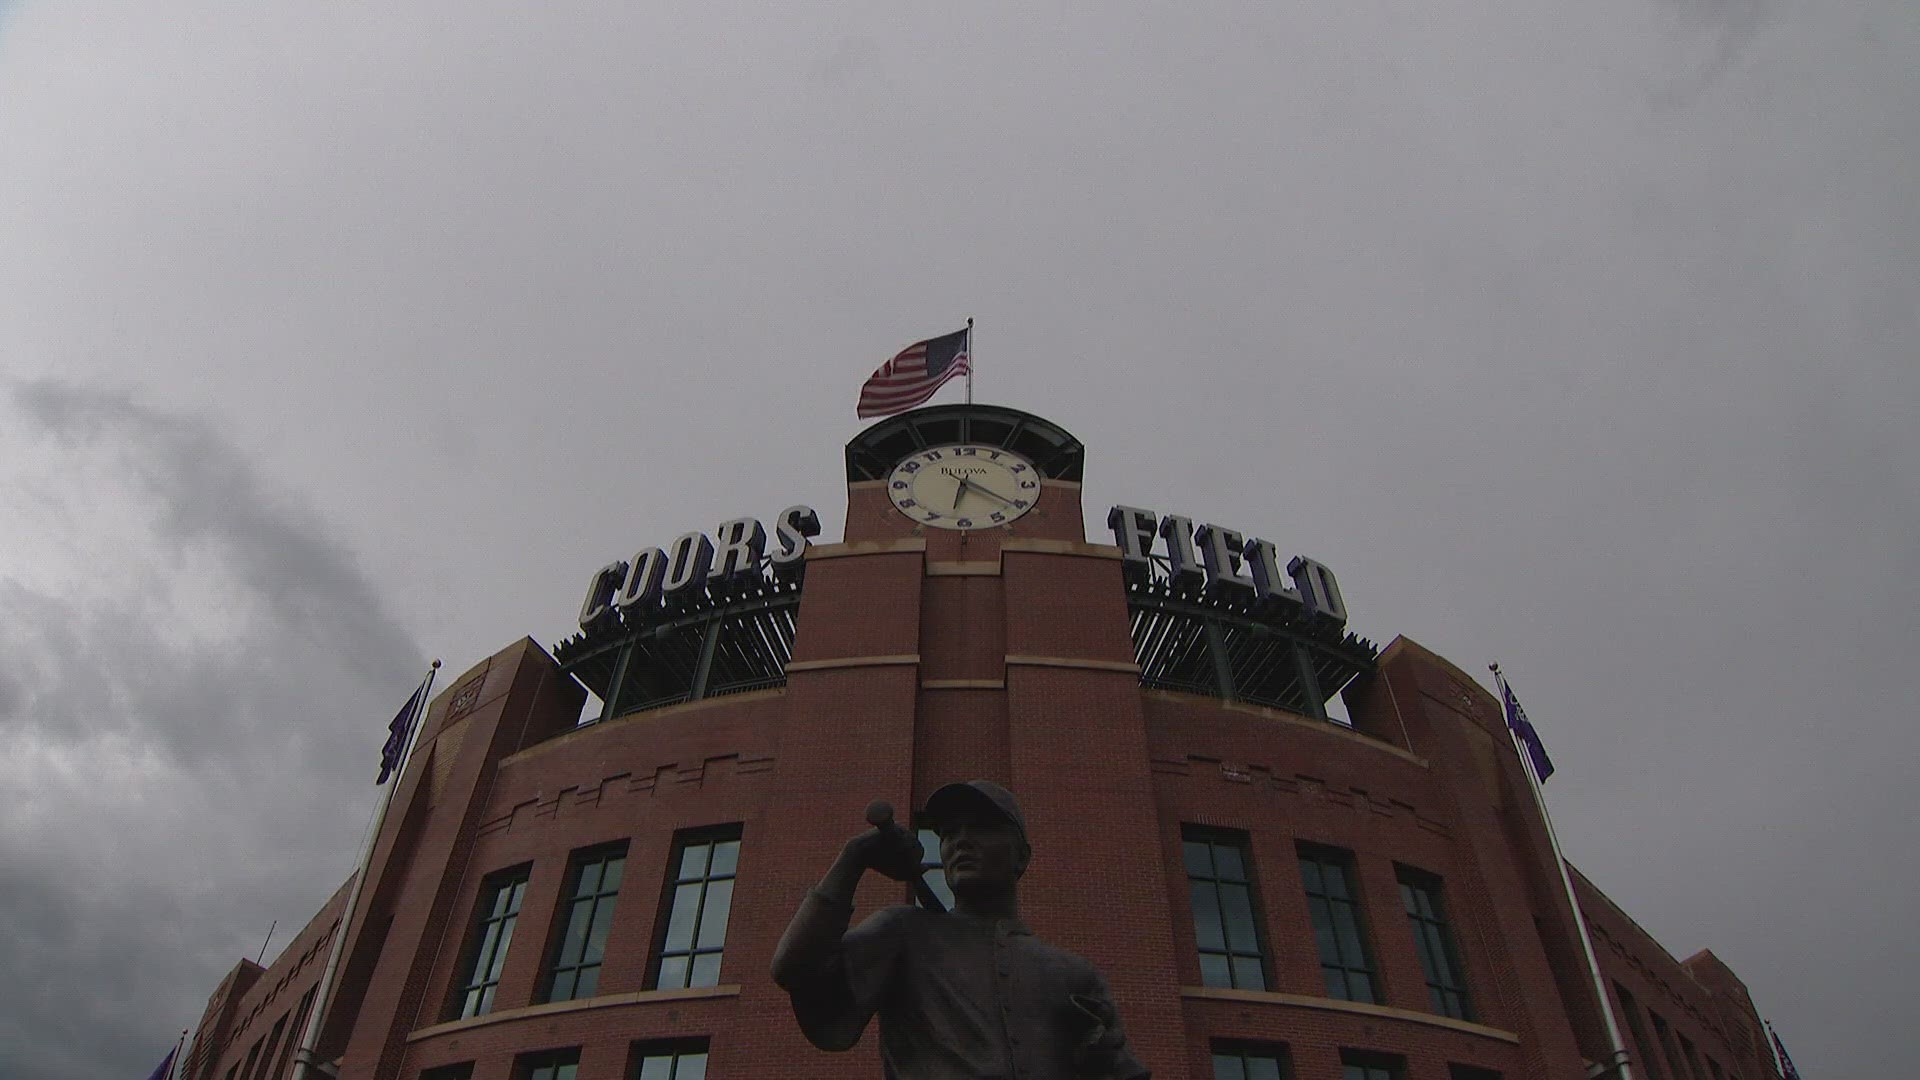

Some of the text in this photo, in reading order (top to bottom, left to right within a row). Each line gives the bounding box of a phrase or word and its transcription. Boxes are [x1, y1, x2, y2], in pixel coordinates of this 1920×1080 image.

[924, 451, 942, 461] 11
[953, 448, 976, 456] 12
[900, 461, 920, 473] 10
[1011, 464, 1026, 474] 2
[893, 481, 907, 490] 9
[1021, 481, 1036, 489] 3
[899, 498, 916, 508] 8
[924, 511, 942, 521] 7
[990, 511, 1006, 523] 5
[957, 518, 972, 528] 6
[578, 505, 1347, 624] COORS FIELD
